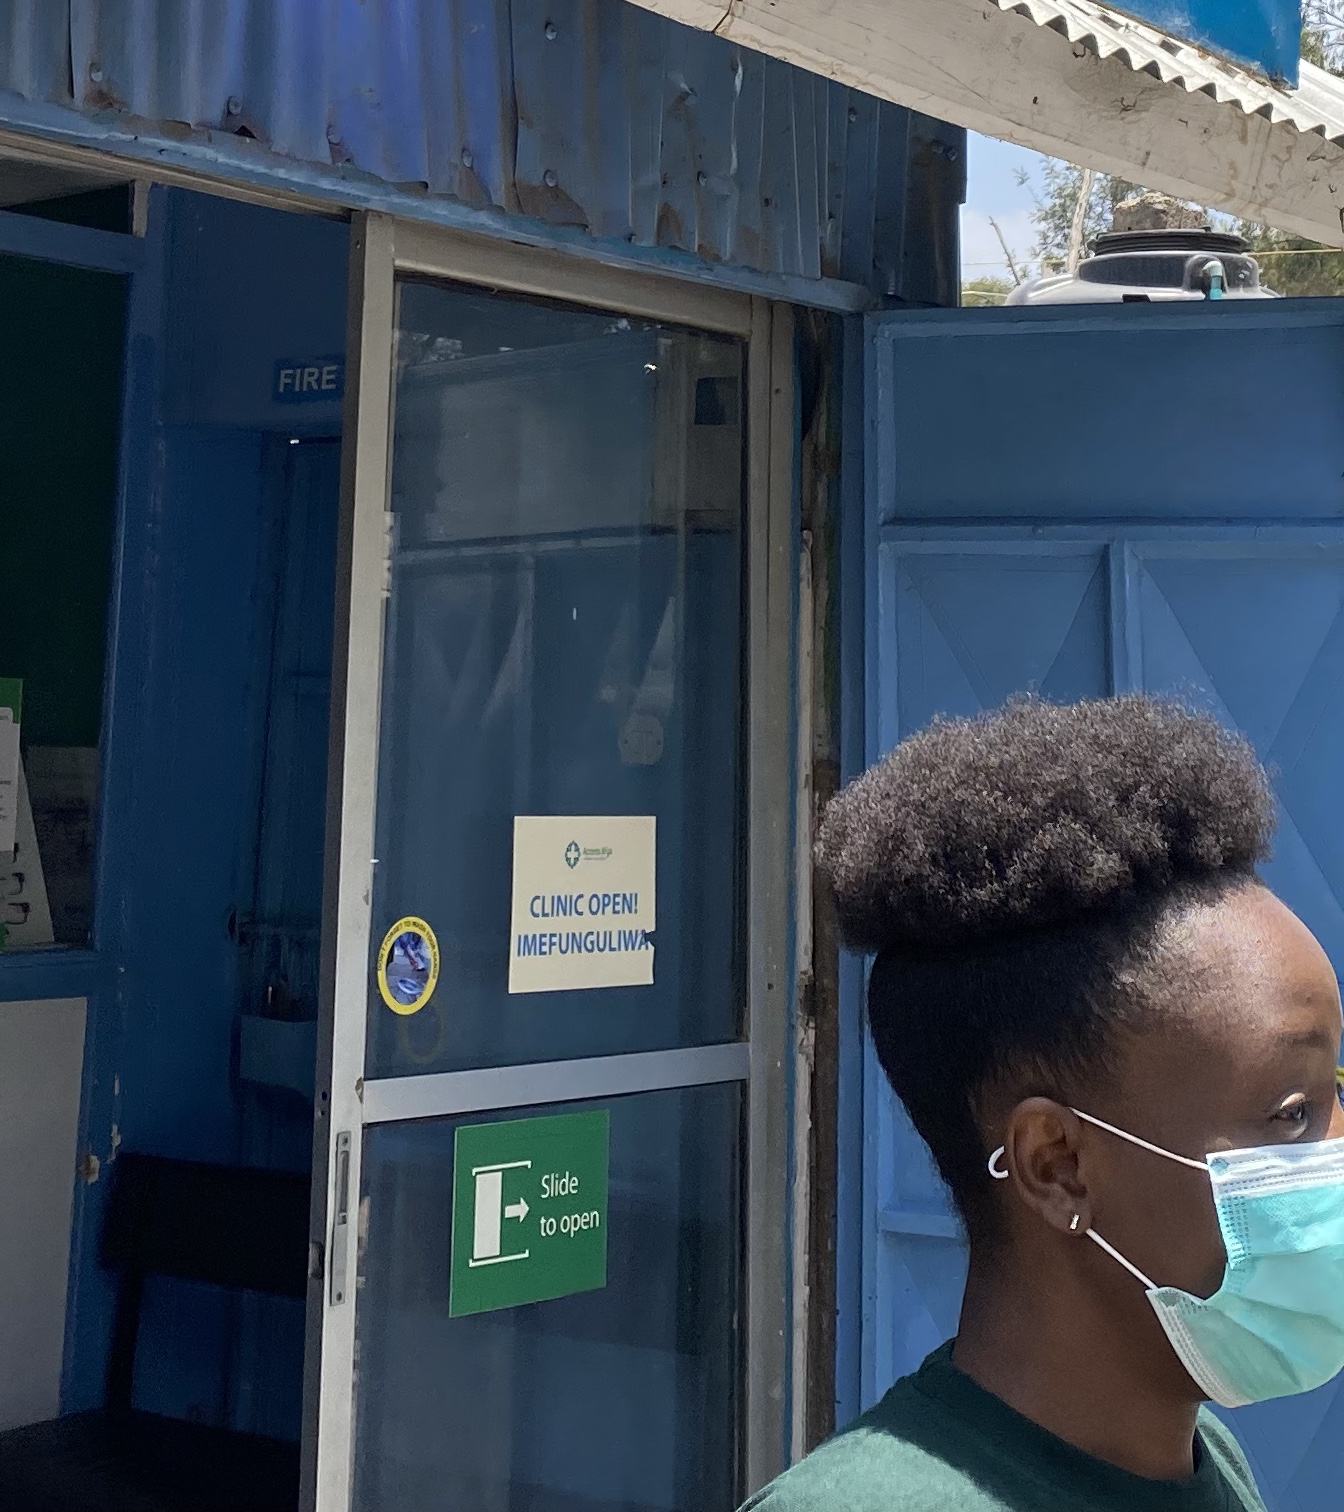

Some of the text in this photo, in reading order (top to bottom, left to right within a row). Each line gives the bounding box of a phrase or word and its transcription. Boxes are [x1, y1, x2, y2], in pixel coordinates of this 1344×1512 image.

[279, 365, 338, 393] FIRE
[530, 893, 638, 918] CLINIC OPEN!
[517, 929, 649, 957] IMEFUNGULIWA
[540, 1171, 579, 1199] Slide
[540, 1210, 600, 1238] to open
